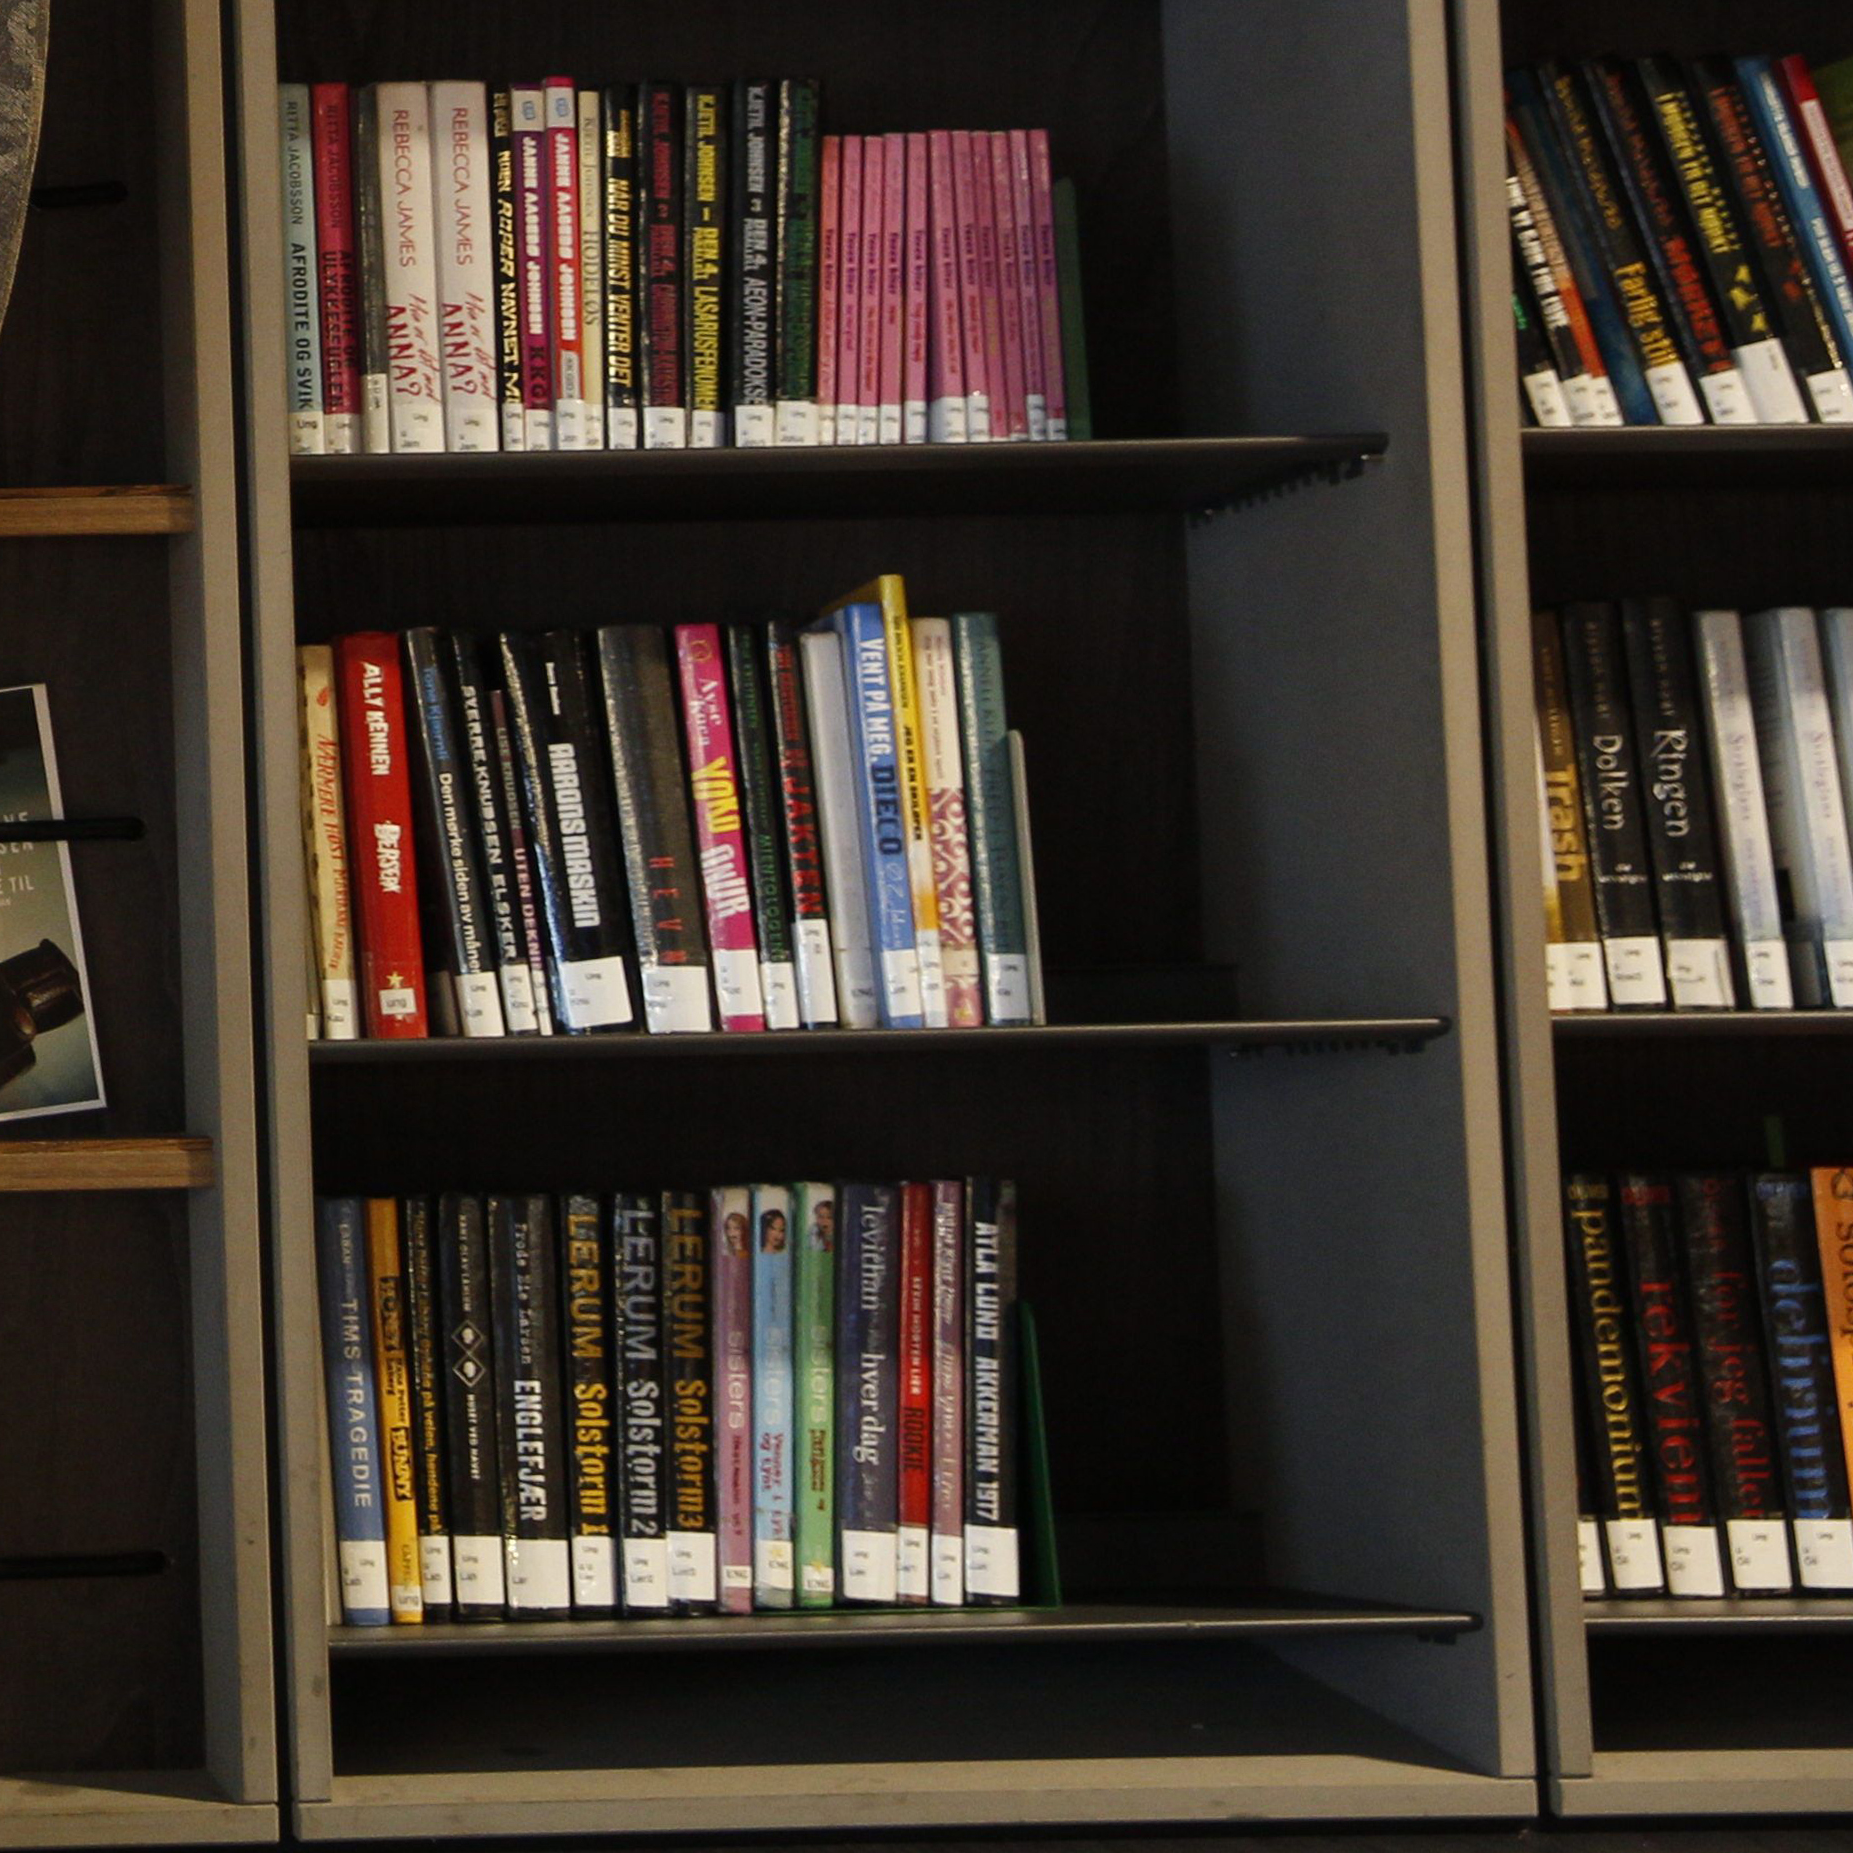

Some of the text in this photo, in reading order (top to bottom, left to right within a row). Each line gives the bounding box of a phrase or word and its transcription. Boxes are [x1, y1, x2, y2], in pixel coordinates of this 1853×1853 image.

[392, 109, 414, 267] REBECCA JAMES
[452, 108, 472, 266] REBECCA JAMES
[522, 136, 538, 189] JANNE
[554, 133, 569, 187] JANNE
[697, 141, 716, 202] JOHNSEN
[746, 133, 764, 193] JOHNSEN
[608, 213, 630, 235] DU
[608, 239, 630, 289] MINST
[291, 243, 308, 332] AFRODITE
[608, 293, 631, 352] VENTER
[296, 338, 310, 361] OG
[441, 303, 477, 394] ANNA?
[608, 355, 632, 388] DET
[361, 661, 391, 776] ALLY KENNEN
[859, 637, 892, 714] VENT PÅ
[1544, 763, 1586, 882] Trash
[1591, 734, 1630, 831] Dolken
[1649, 728, 1692, 838] Ringen
[8, 875, 35, 893] TIL
[372, 821, 402, 893] BERSERK
[437, 772, 473, 923] Den mørke siden av
[512, 847, 530, 901] UTEN
[561, 836, 600, 928] MASKIN
[691, 756, 750, 919] YOKO ONUR
[788, 777, 825, 914] JAKTEN
[492, 874, 517, 960] ELSKER
[512, 1222, 534, 1366] Frode Larsen
[566, 1213, 603, 1359] LERUM
[668, 1207, 707, 1360] LERUM
[621, 1210, 662, 1534] LERUM Solstorm 2
[726, 1330, 747, 1429] sisters
[851, 1204, 887, 1466] levithan hver dag
[340, 1298, 372, 1508] TIMS TRAGEDIE
[420, 1391, 433, 1408] på
[573, 1382, 609, 1514] Solstorm
[672, 1379, 710, 1512] Solstorm
[974, 1355, 999, 1474] AKKERMAN
[512, 1379, 547, 1522] ENGLEFJÆR
